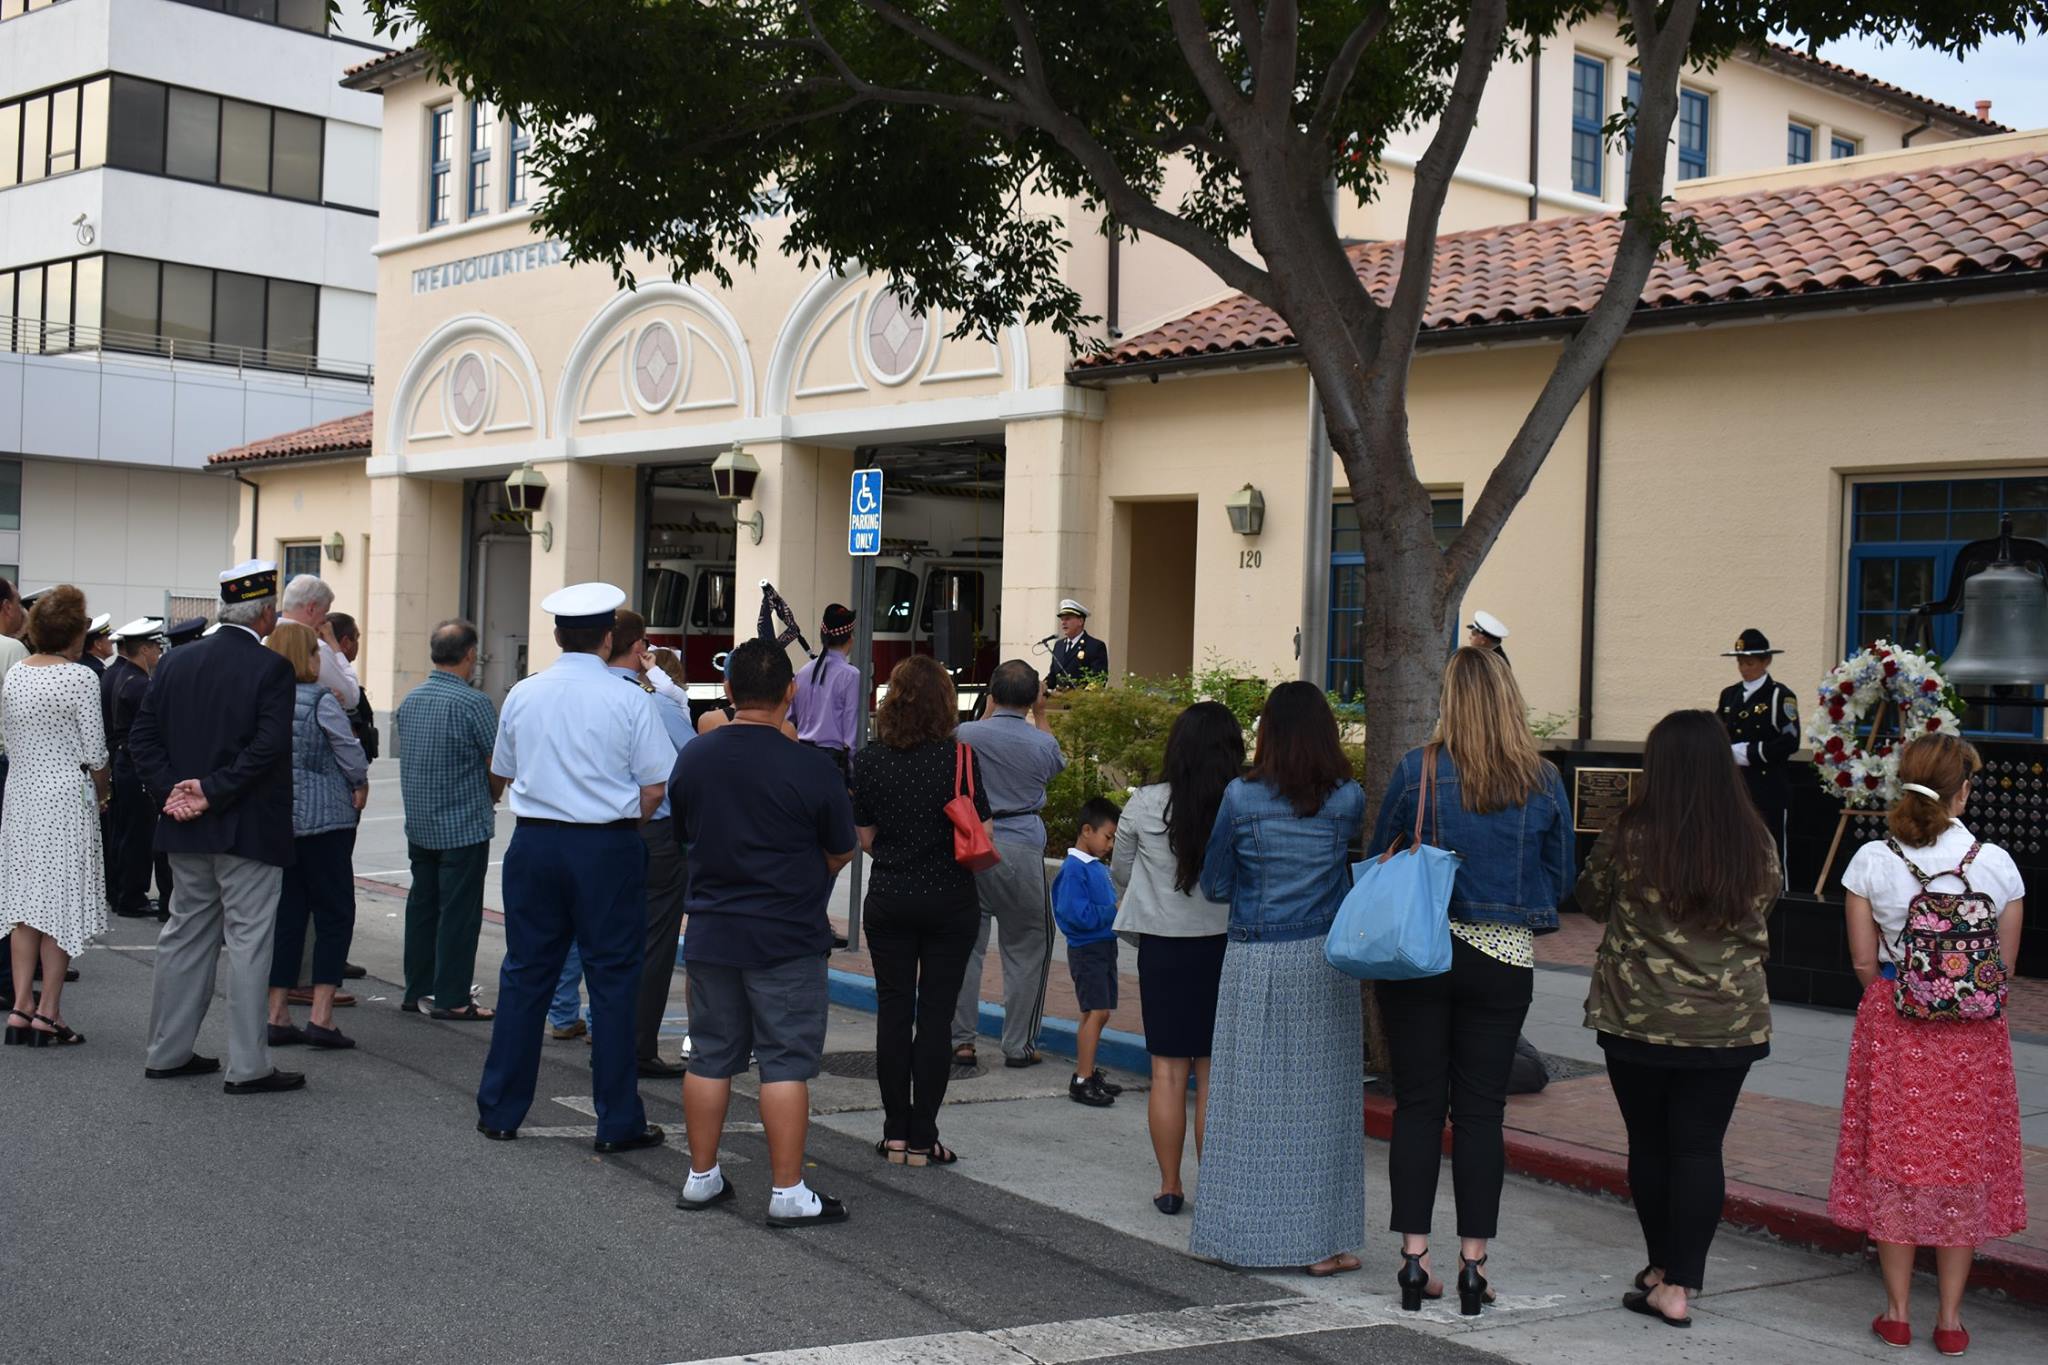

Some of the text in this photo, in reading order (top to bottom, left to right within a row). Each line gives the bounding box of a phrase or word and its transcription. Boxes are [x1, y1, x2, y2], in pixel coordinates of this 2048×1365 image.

[415, 239, 562, 294] HEADQUARTERS
[852, 514, 879, 530] PARKING
[855, 532, 874, 549] ONLY
[1239, 549, 1262, 569] 120
